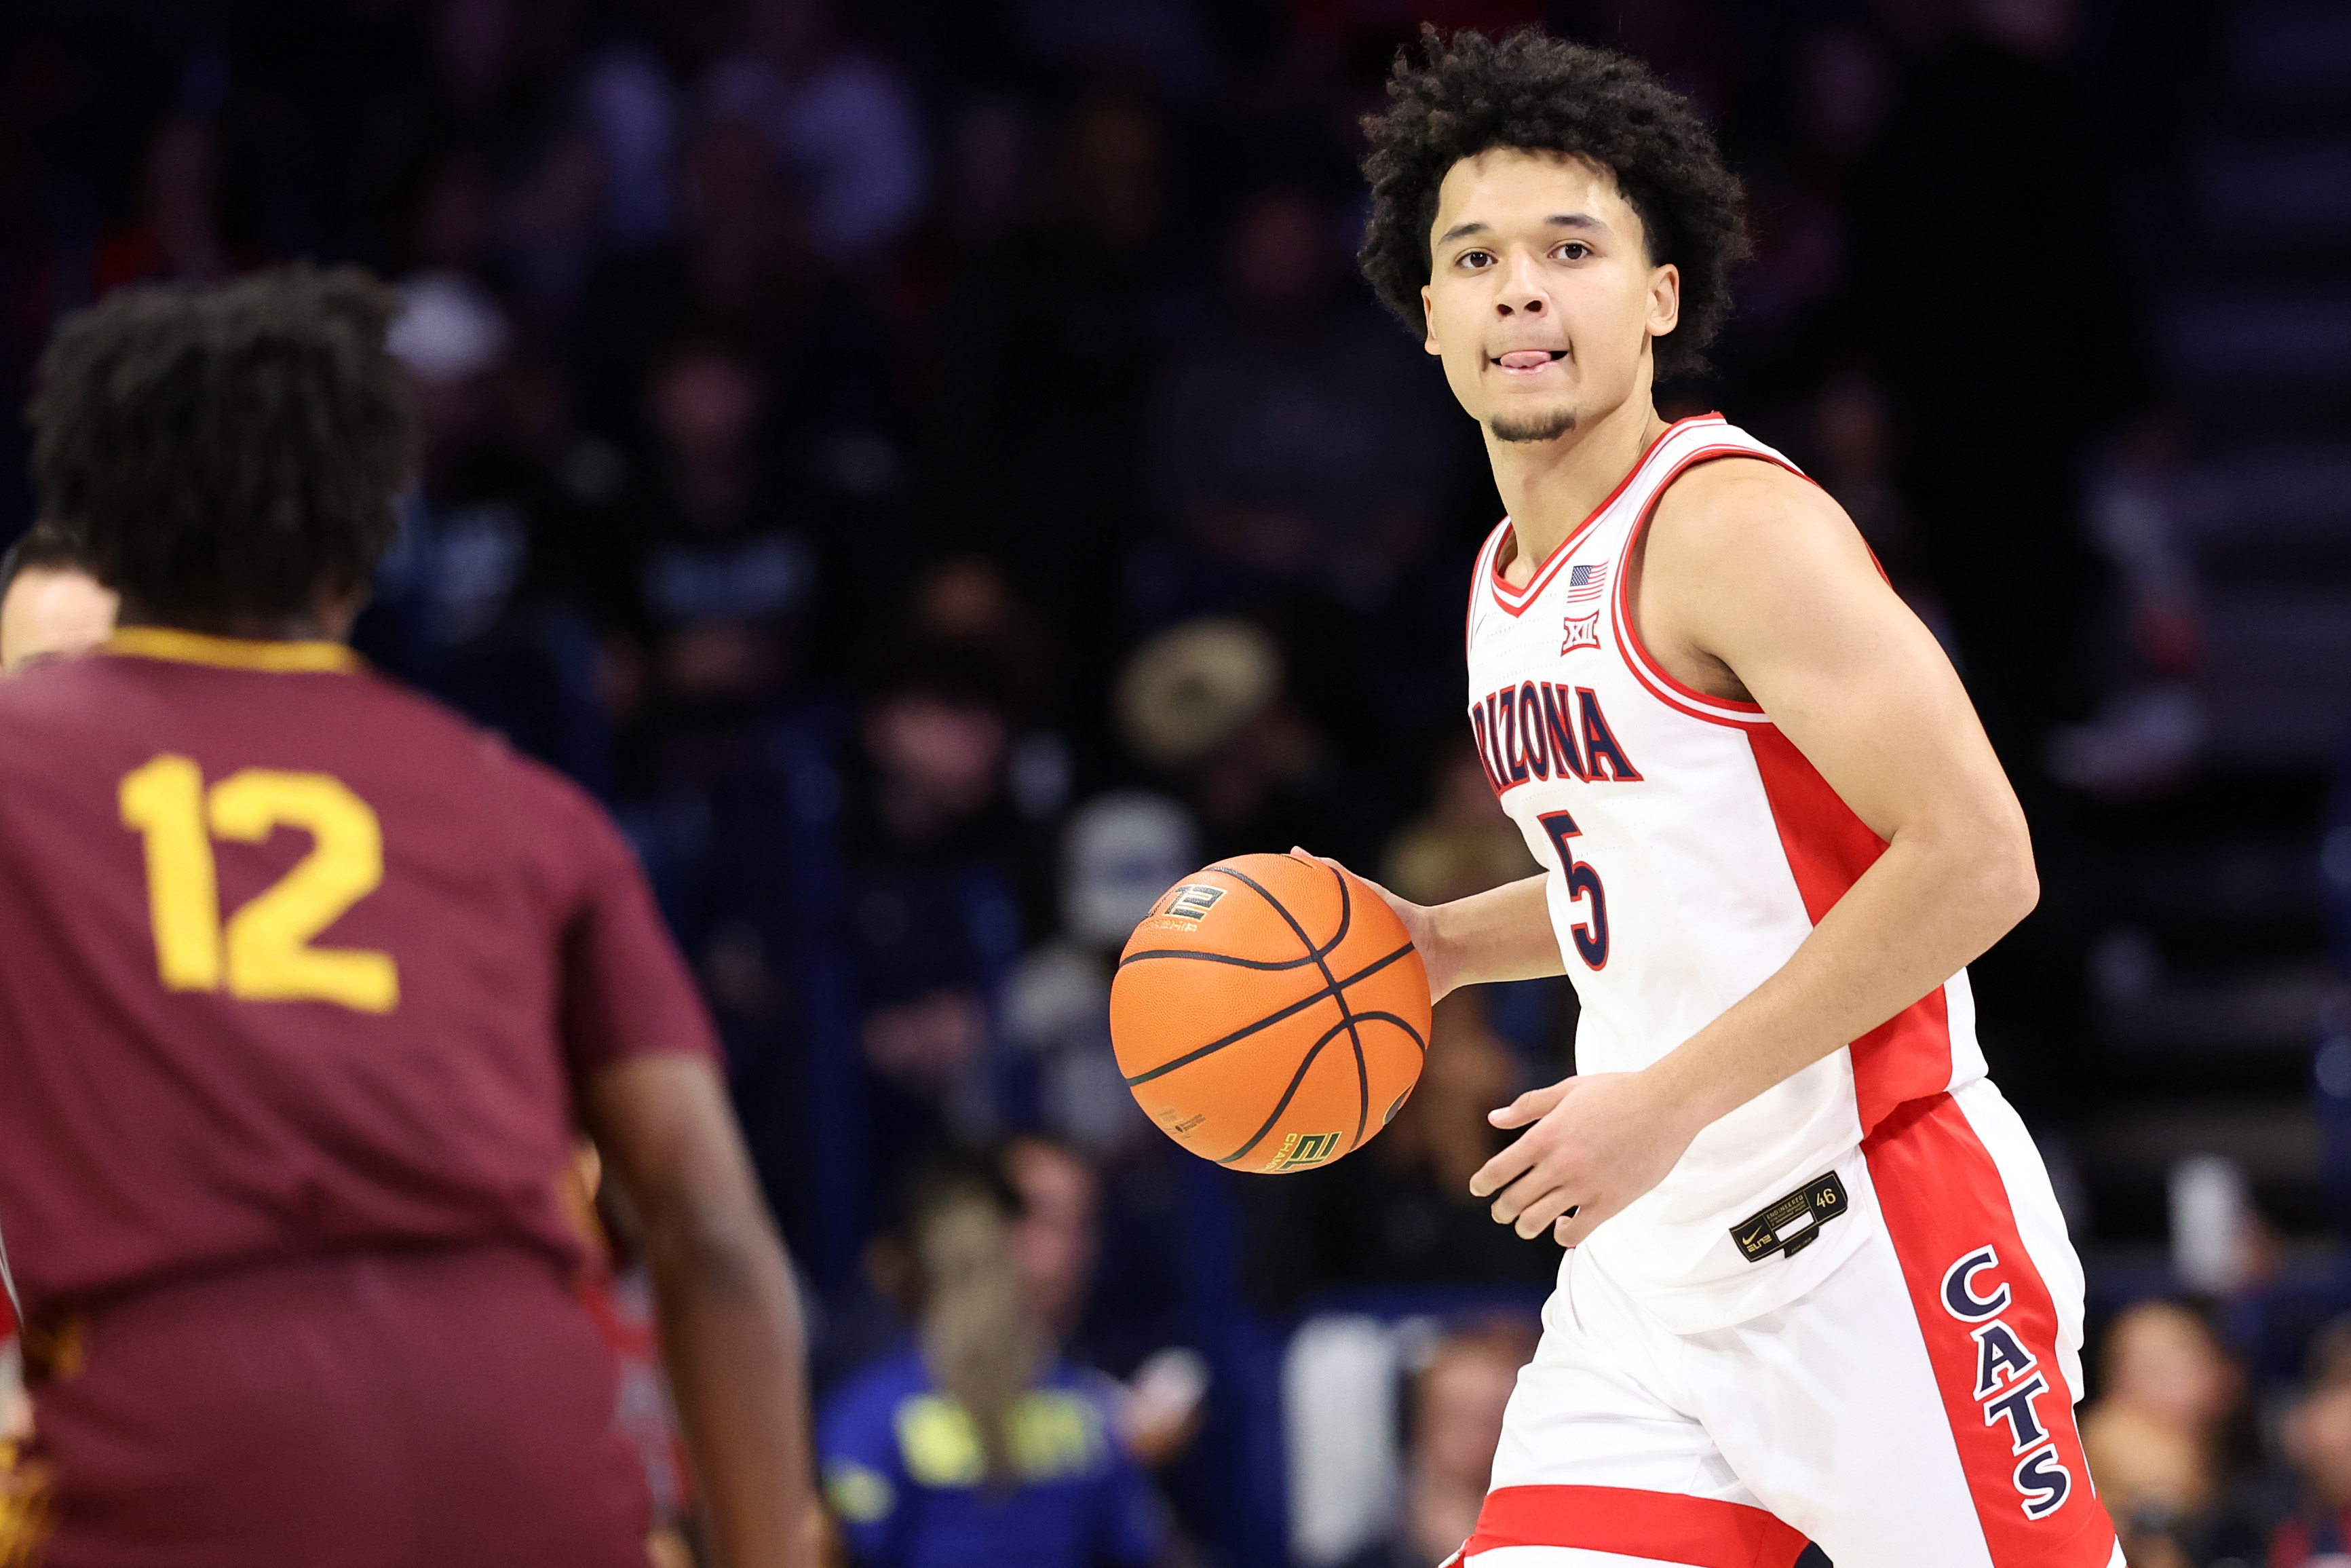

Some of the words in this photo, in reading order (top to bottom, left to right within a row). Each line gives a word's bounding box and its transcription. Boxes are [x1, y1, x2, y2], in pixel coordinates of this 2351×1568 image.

[1471, 680, 1645, 799] RIZONA
[117, 753, 400, 1014] 12
[1536, 809, 1609, 972] 5
[1746, 1234, 1773, 1253] ELITE
[1816, 1188, 1837, 1208] 46
[1940, 1244, 2071, 1521] CATS
